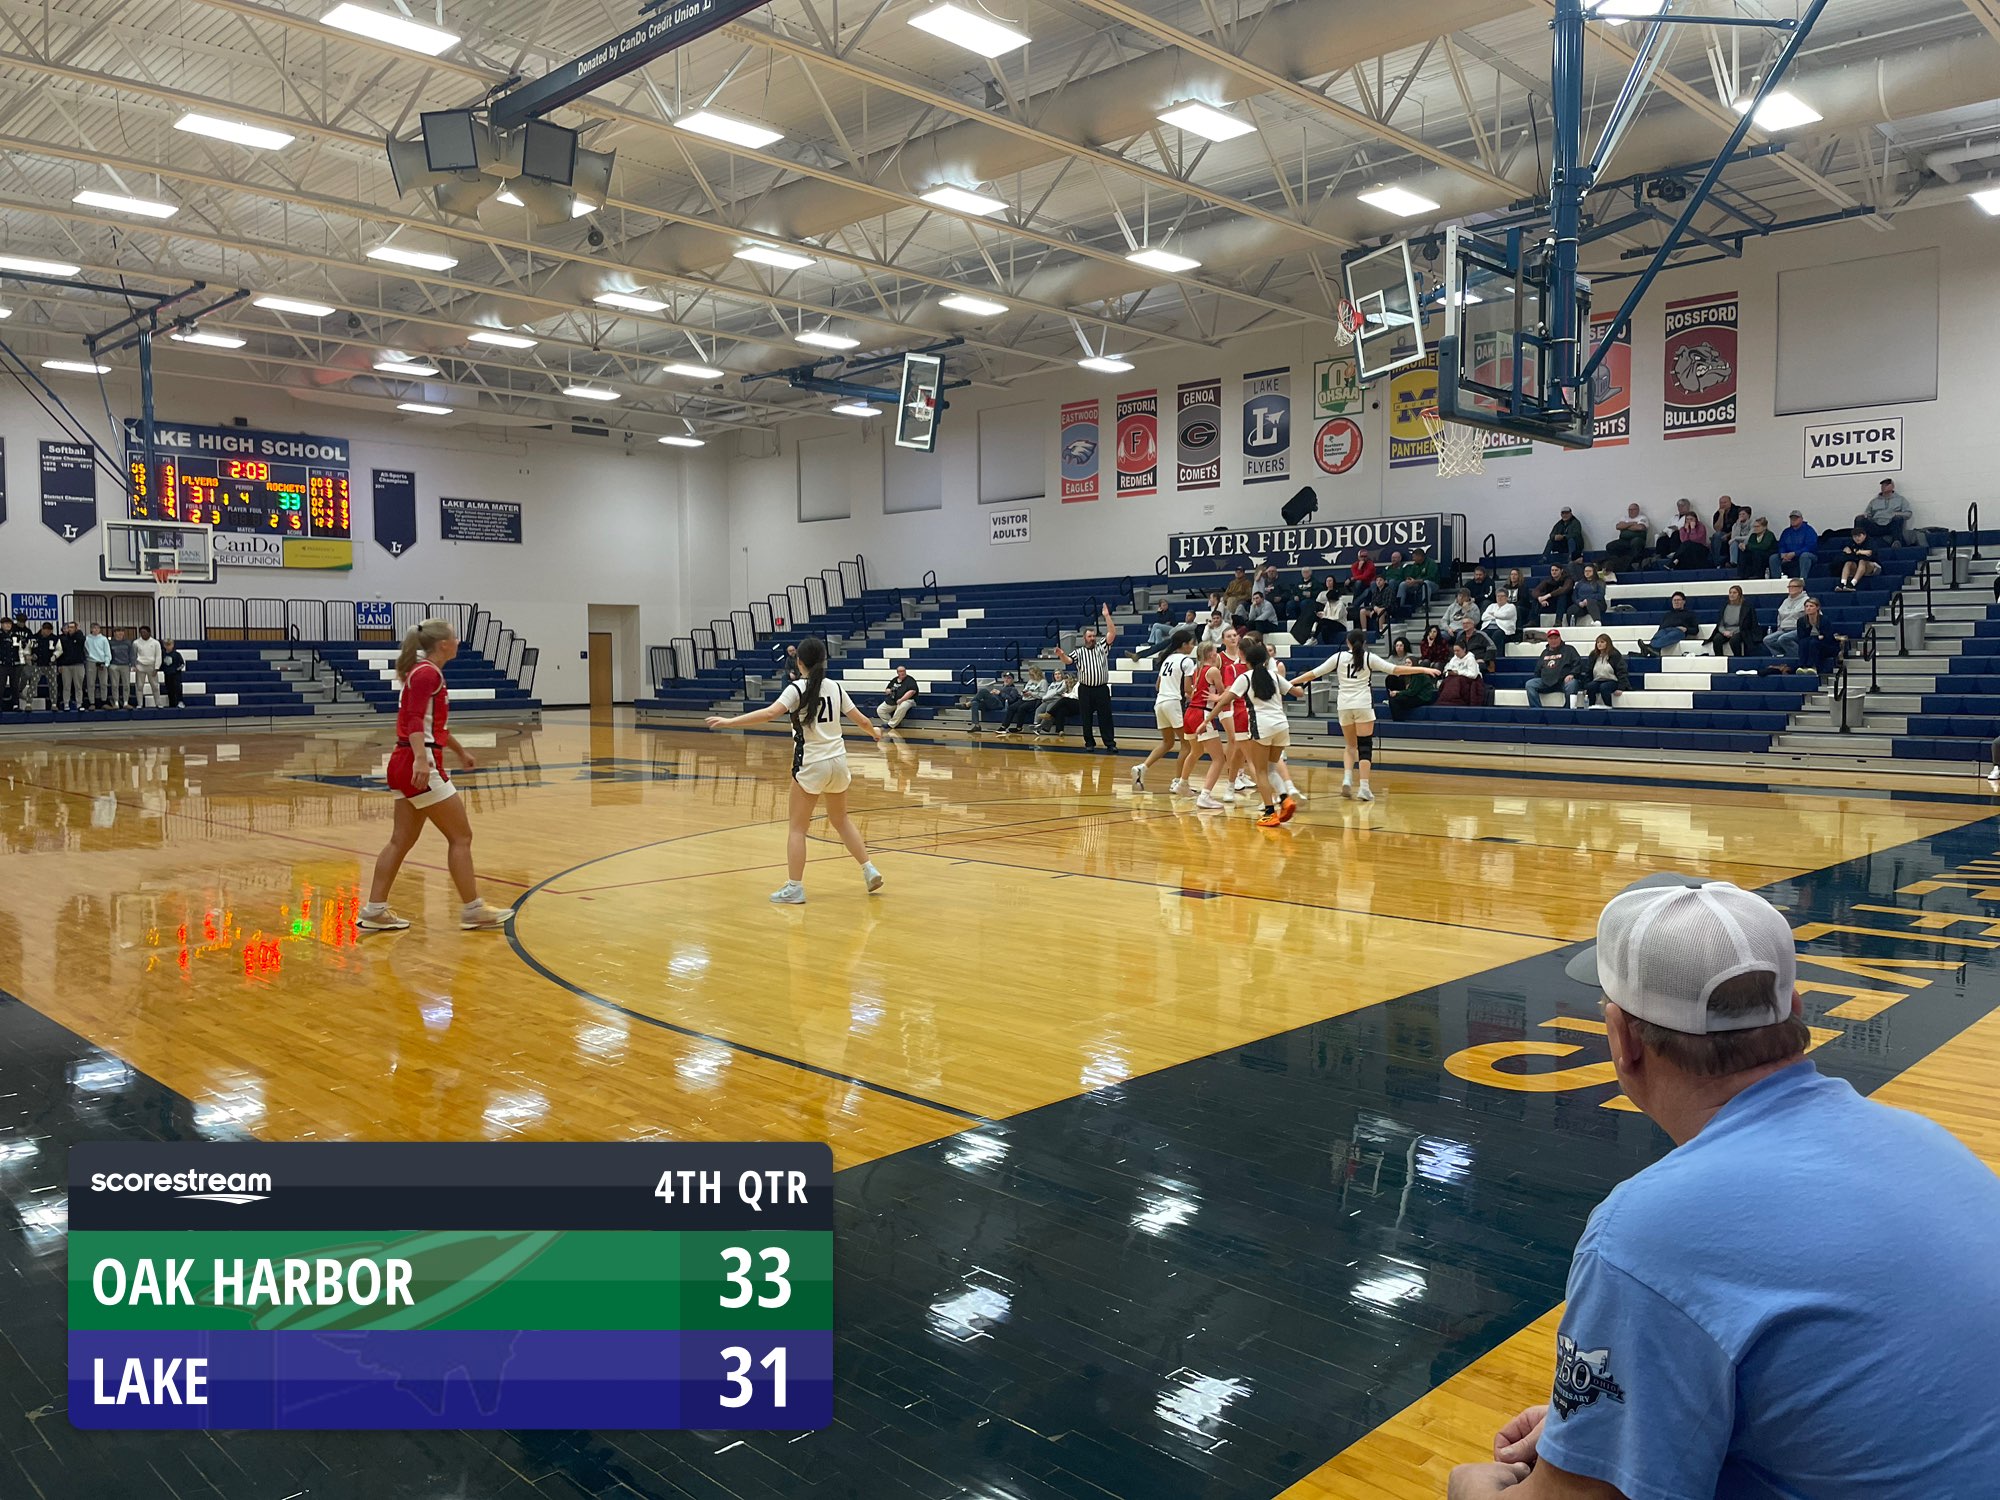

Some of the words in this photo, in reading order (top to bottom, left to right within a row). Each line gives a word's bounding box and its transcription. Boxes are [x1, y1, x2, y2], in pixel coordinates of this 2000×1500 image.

[578, 52, 607, 76] Donated
[608, 45, 618, 60] by
[620, 31, 646, 53] CanDo
[648, 14, 672, 39] Credit
[674, 4, 700, 24] Union
[1666, 305, 1737, 332] ROSSFORD
[1253, 378, 1279, 395] LAKE
[1183, 389, 1215, 406] GENOA
[1319, 387, 1359, 404] OHSAA
[1117, 399, 1156, 417] FOSTORIA
[1665, 403, 1735, 427] BULLDOGS
[1061, 408, 1098, 425] EASTWOOD
[1593, 416, 1627, 436] GHTS
[1130, 430, 1143, 455] F
[1810, 428, 1896, 448] VISITOR
[48, 445, 86, 456] Softball
[198, 433, 254, 454] HIGH
[261, 439, 347, 462] SCHOOL
[1391, 440, 1443, 458] PANTHER
[1247, 457, 1285, 474] FLYERS
[1810, 449, 1894, 469] ADULTS
[230, 460, 268, 480] 2:03
[1179, 464, 1218, 482] COMETS
[181, 475, 219, 488] FLYERS
[266, 482, 306, 494] ROCKETS
[311, 477, 323, 488] 00
[1065, 481, 1094, 494] EAGLES
[1120, 472, 1153, 488] REDMEN
[191, 485, 215, 504] 31
[239, 491, 250, 504] 4
[278, 491, 300, 511] 33
[442, 500, 465, 509] LAKE
[467, 501, 490, 510] ALMA
[491, 503, 519, 512] MATER
[190, 509, 202, 524] 2
[211, 510, 221, 525] 3
[269, 513, 279, 528] 2
[289, 515, 302, 530] 5
[992, 514, 1028, 526] VISITOR
[992, 528, 1028, 540] ADULTS
[1179, 533, 1251, 558] FLYER
[1257, 519, 1427, 554] FIELDHOUSE
[212, 534, 280, 554] CanDo
[247, 556, 282, 566] UNION
[21, 595, 48, 607] HOME
[361, 602, 387, 613] PEP
[13, 607, 57, 620] STUDENT
[358, 613, 391, 624] BAND
[1162, 661, 1174, 677] 24
[1347, 663, 1358, 679] 12
[817, 696, 833, 724] 21
[1593, 1377, 1616, 1392] OHIO
